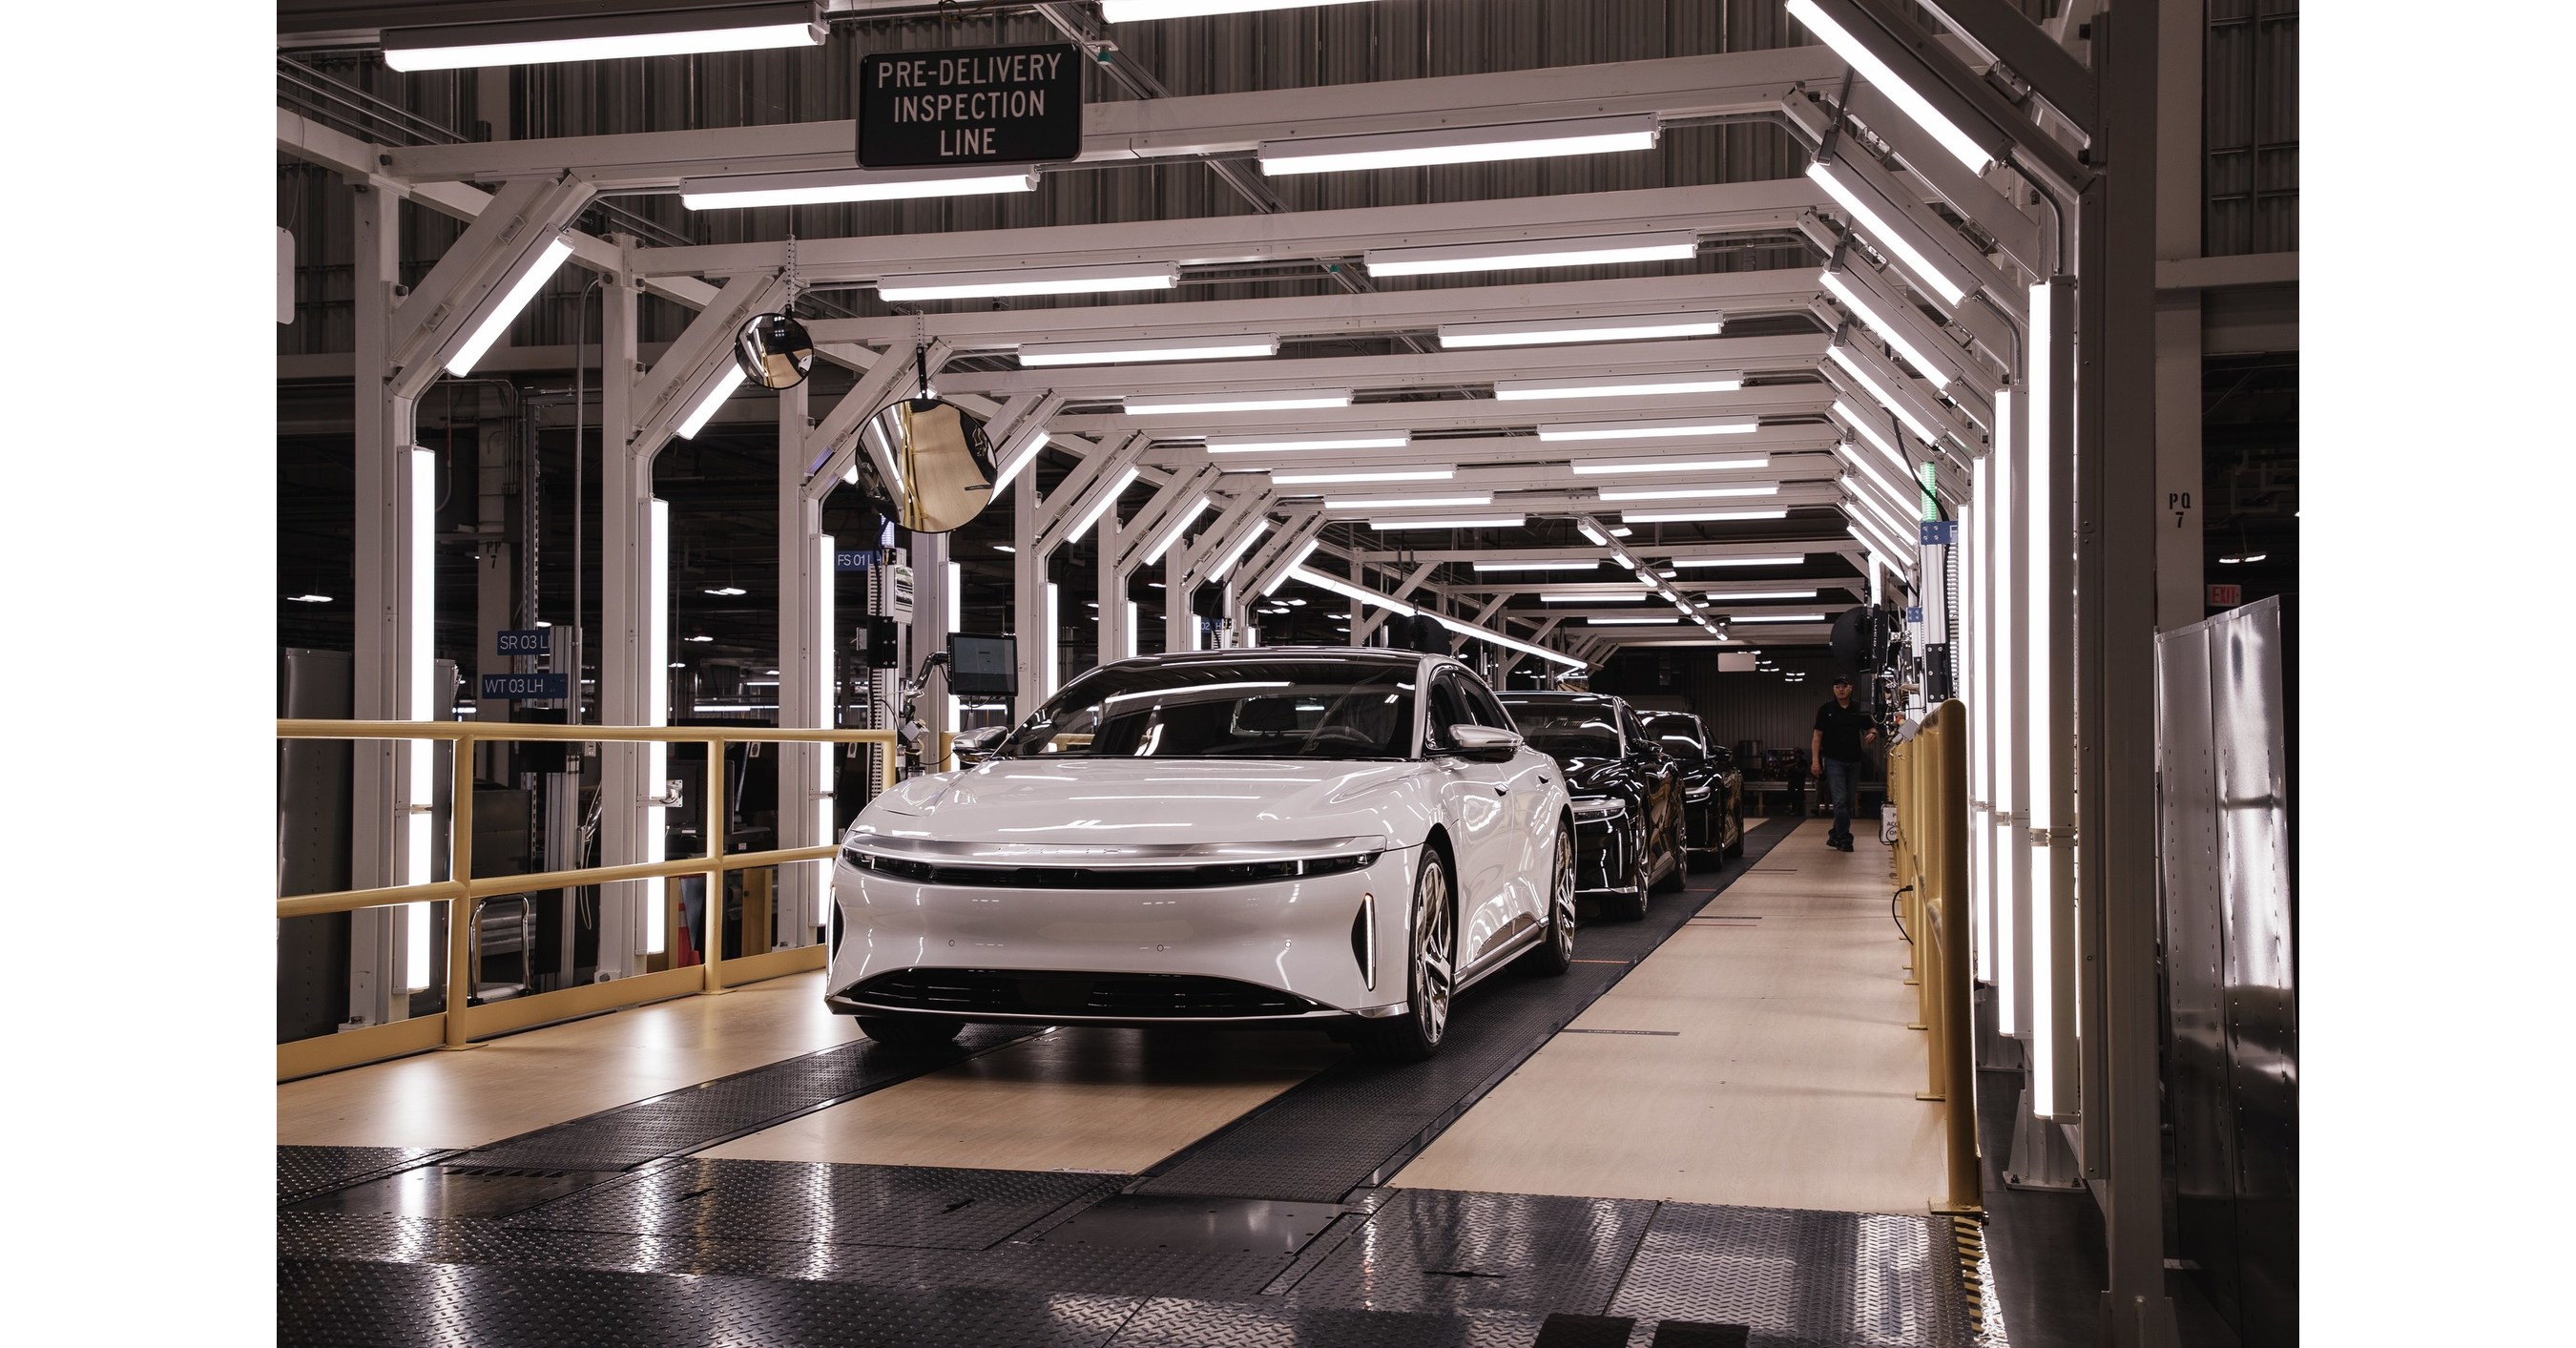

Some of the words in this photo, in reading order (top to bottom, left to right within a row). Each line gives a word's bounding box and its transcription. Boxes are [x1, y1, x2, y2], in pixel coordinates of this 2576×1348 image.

[878, 52, 1062, 89] PRE-DELIVERY
[894, 90, 1045, 123] INSPECTION
[940, 127, 996, 156] LINE
[2175, 511, 2184, 528] 7
[838, 554, 851, 566] FS
[853, 554, 865, 566] 01
[2212, 586, 2237, 604] EXIT
[500, 635, 518, 650] SR
[520, 634, 537, 650] 03
[540, 635, 551, 649] L
[485, 678, 507, 694] WT
[509, 678, 525, 694] 03
[527, 678, 544, 693] LH
